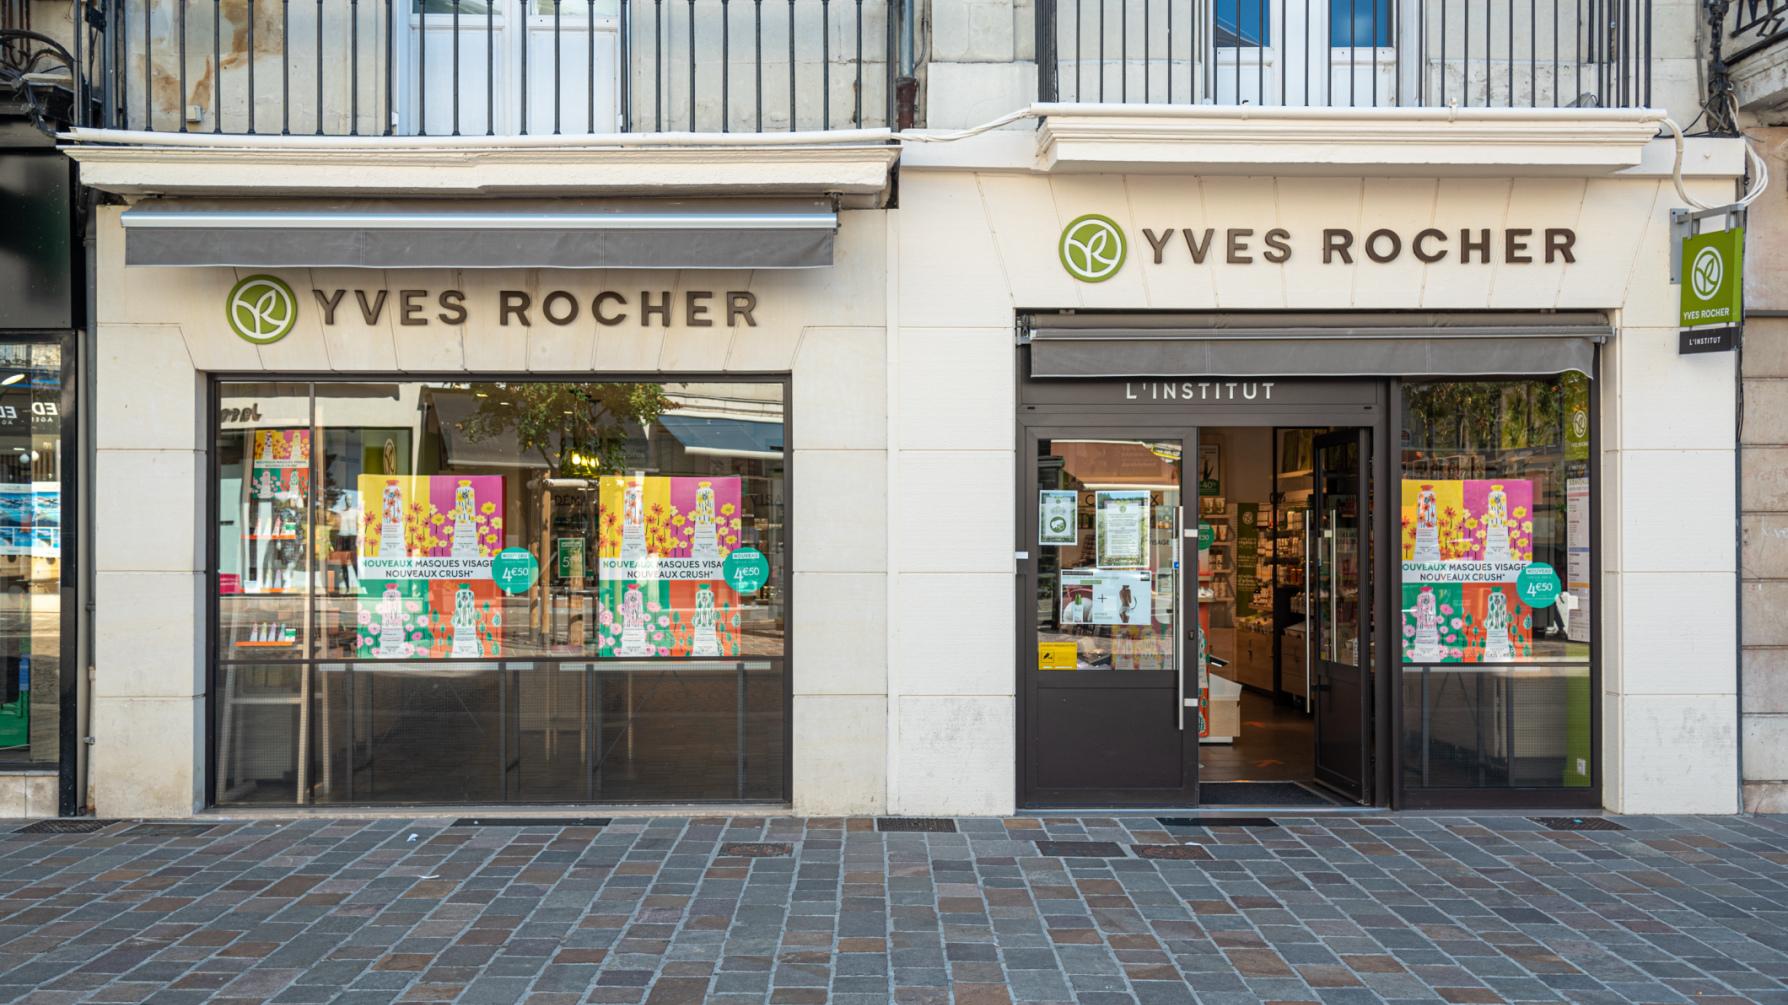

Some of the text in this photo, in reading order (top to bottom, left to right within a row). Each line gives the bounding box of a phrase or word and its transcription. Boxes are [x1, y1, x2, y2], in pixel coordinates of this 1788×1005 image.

[1142, 228, 1577, 265] YVES ROCHER
[312, 289, 758, 328] YVES ROCHER
[1683, 307, 1730, 321] YVES ROCHER
[1689, 336, 1721, 346] L'INSTITUT
[1125, 382, 1275, 400] L'INSTITUT
[415, 559, 460, 568] MASQUES
[656, 560, 701, 569] MASQUES
[1402, 563, 1447, 571] OUVEAUX
[1449, 563, 1493, 571] MASQUES
[385, 569, 438, 578] NOUVEAUX
[502, 567, 529, 582] 4€50
[733, 567, 760, 582] 4€50
[1420, 573, 1471, 581] NOUVEAUX
[1526, 582, 1553, 597] 4€50
